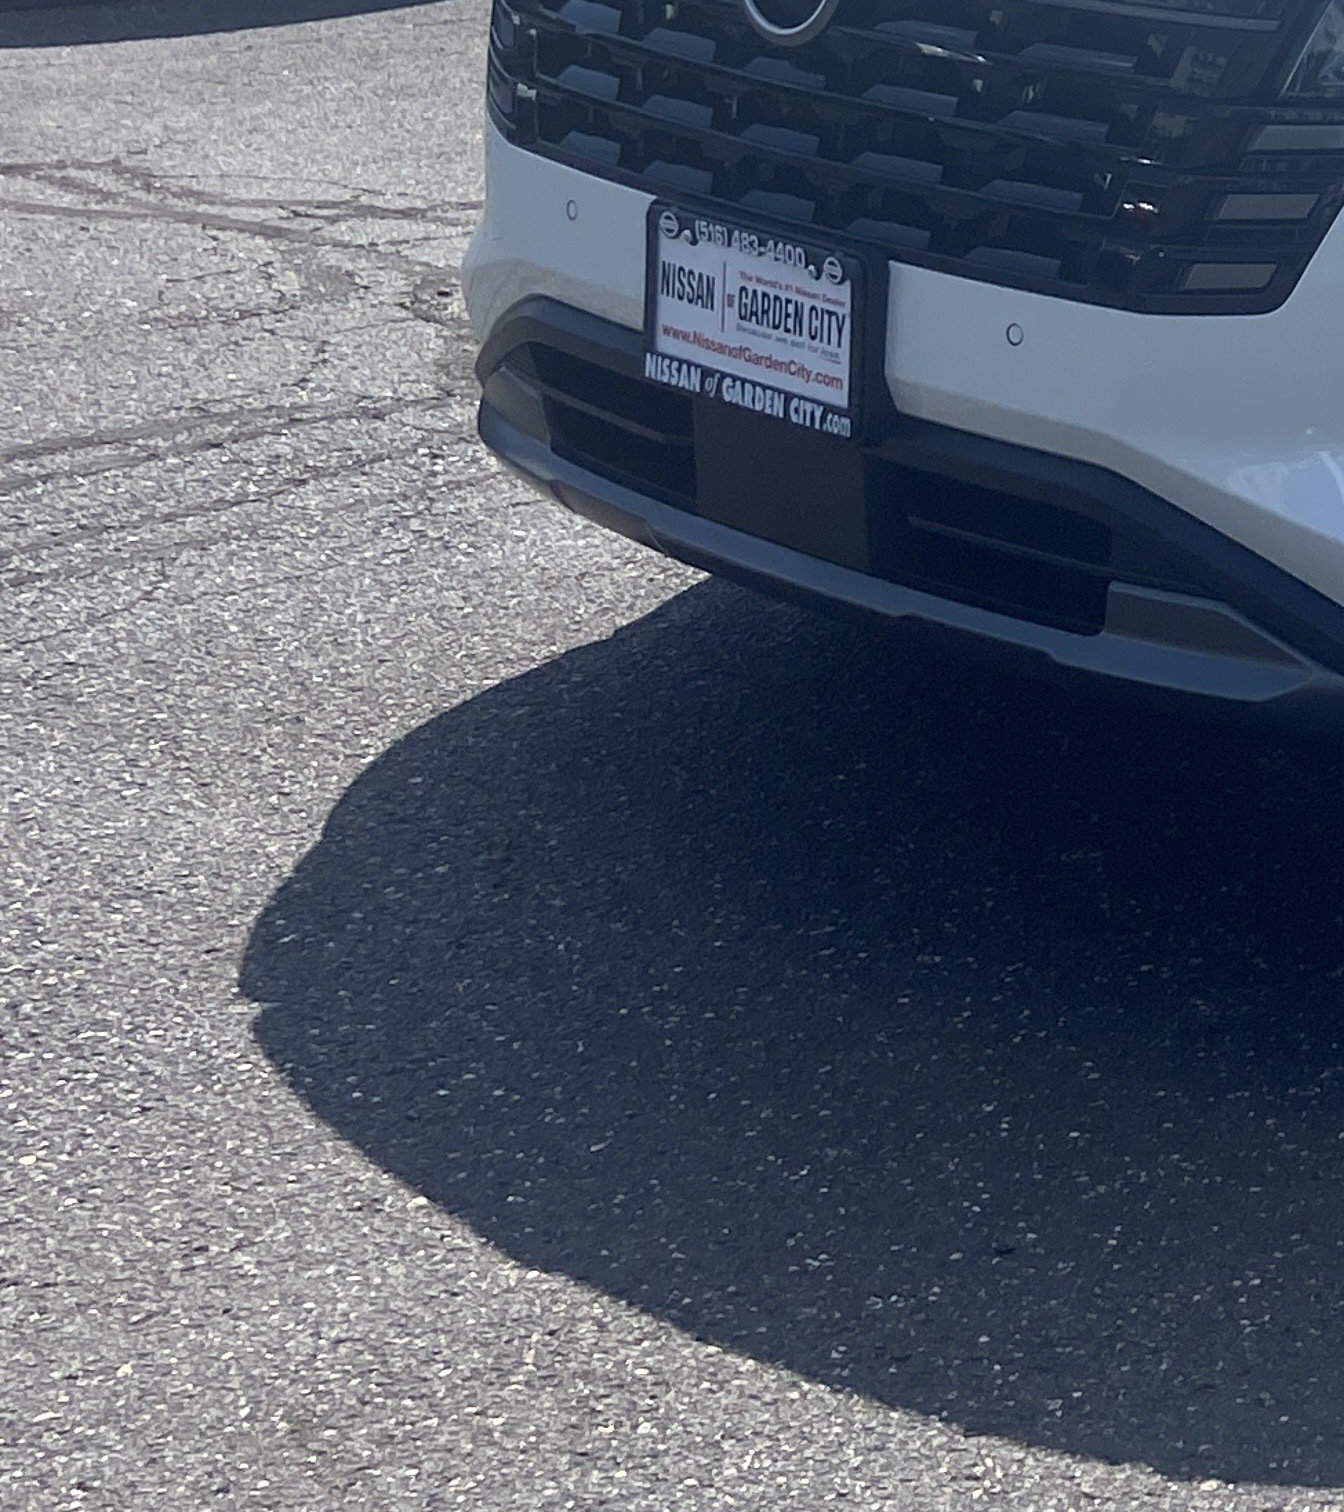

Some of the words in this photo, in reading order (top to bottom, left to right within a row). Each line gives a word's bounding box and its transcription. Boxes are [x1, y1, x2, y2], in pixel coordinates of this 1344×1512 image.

[660, 260, 716, 312] NISSAN
[737, 285, 804, 338] GARDEN
[807, 304, 847, 349] CITY
[645, 352, 702, 393] NISSAN
[704, 372, 721, 398] of
[722, 376, 785, 419] GARDEN
[661, 323, 844, 391] www.NissanofGardenCity.com
